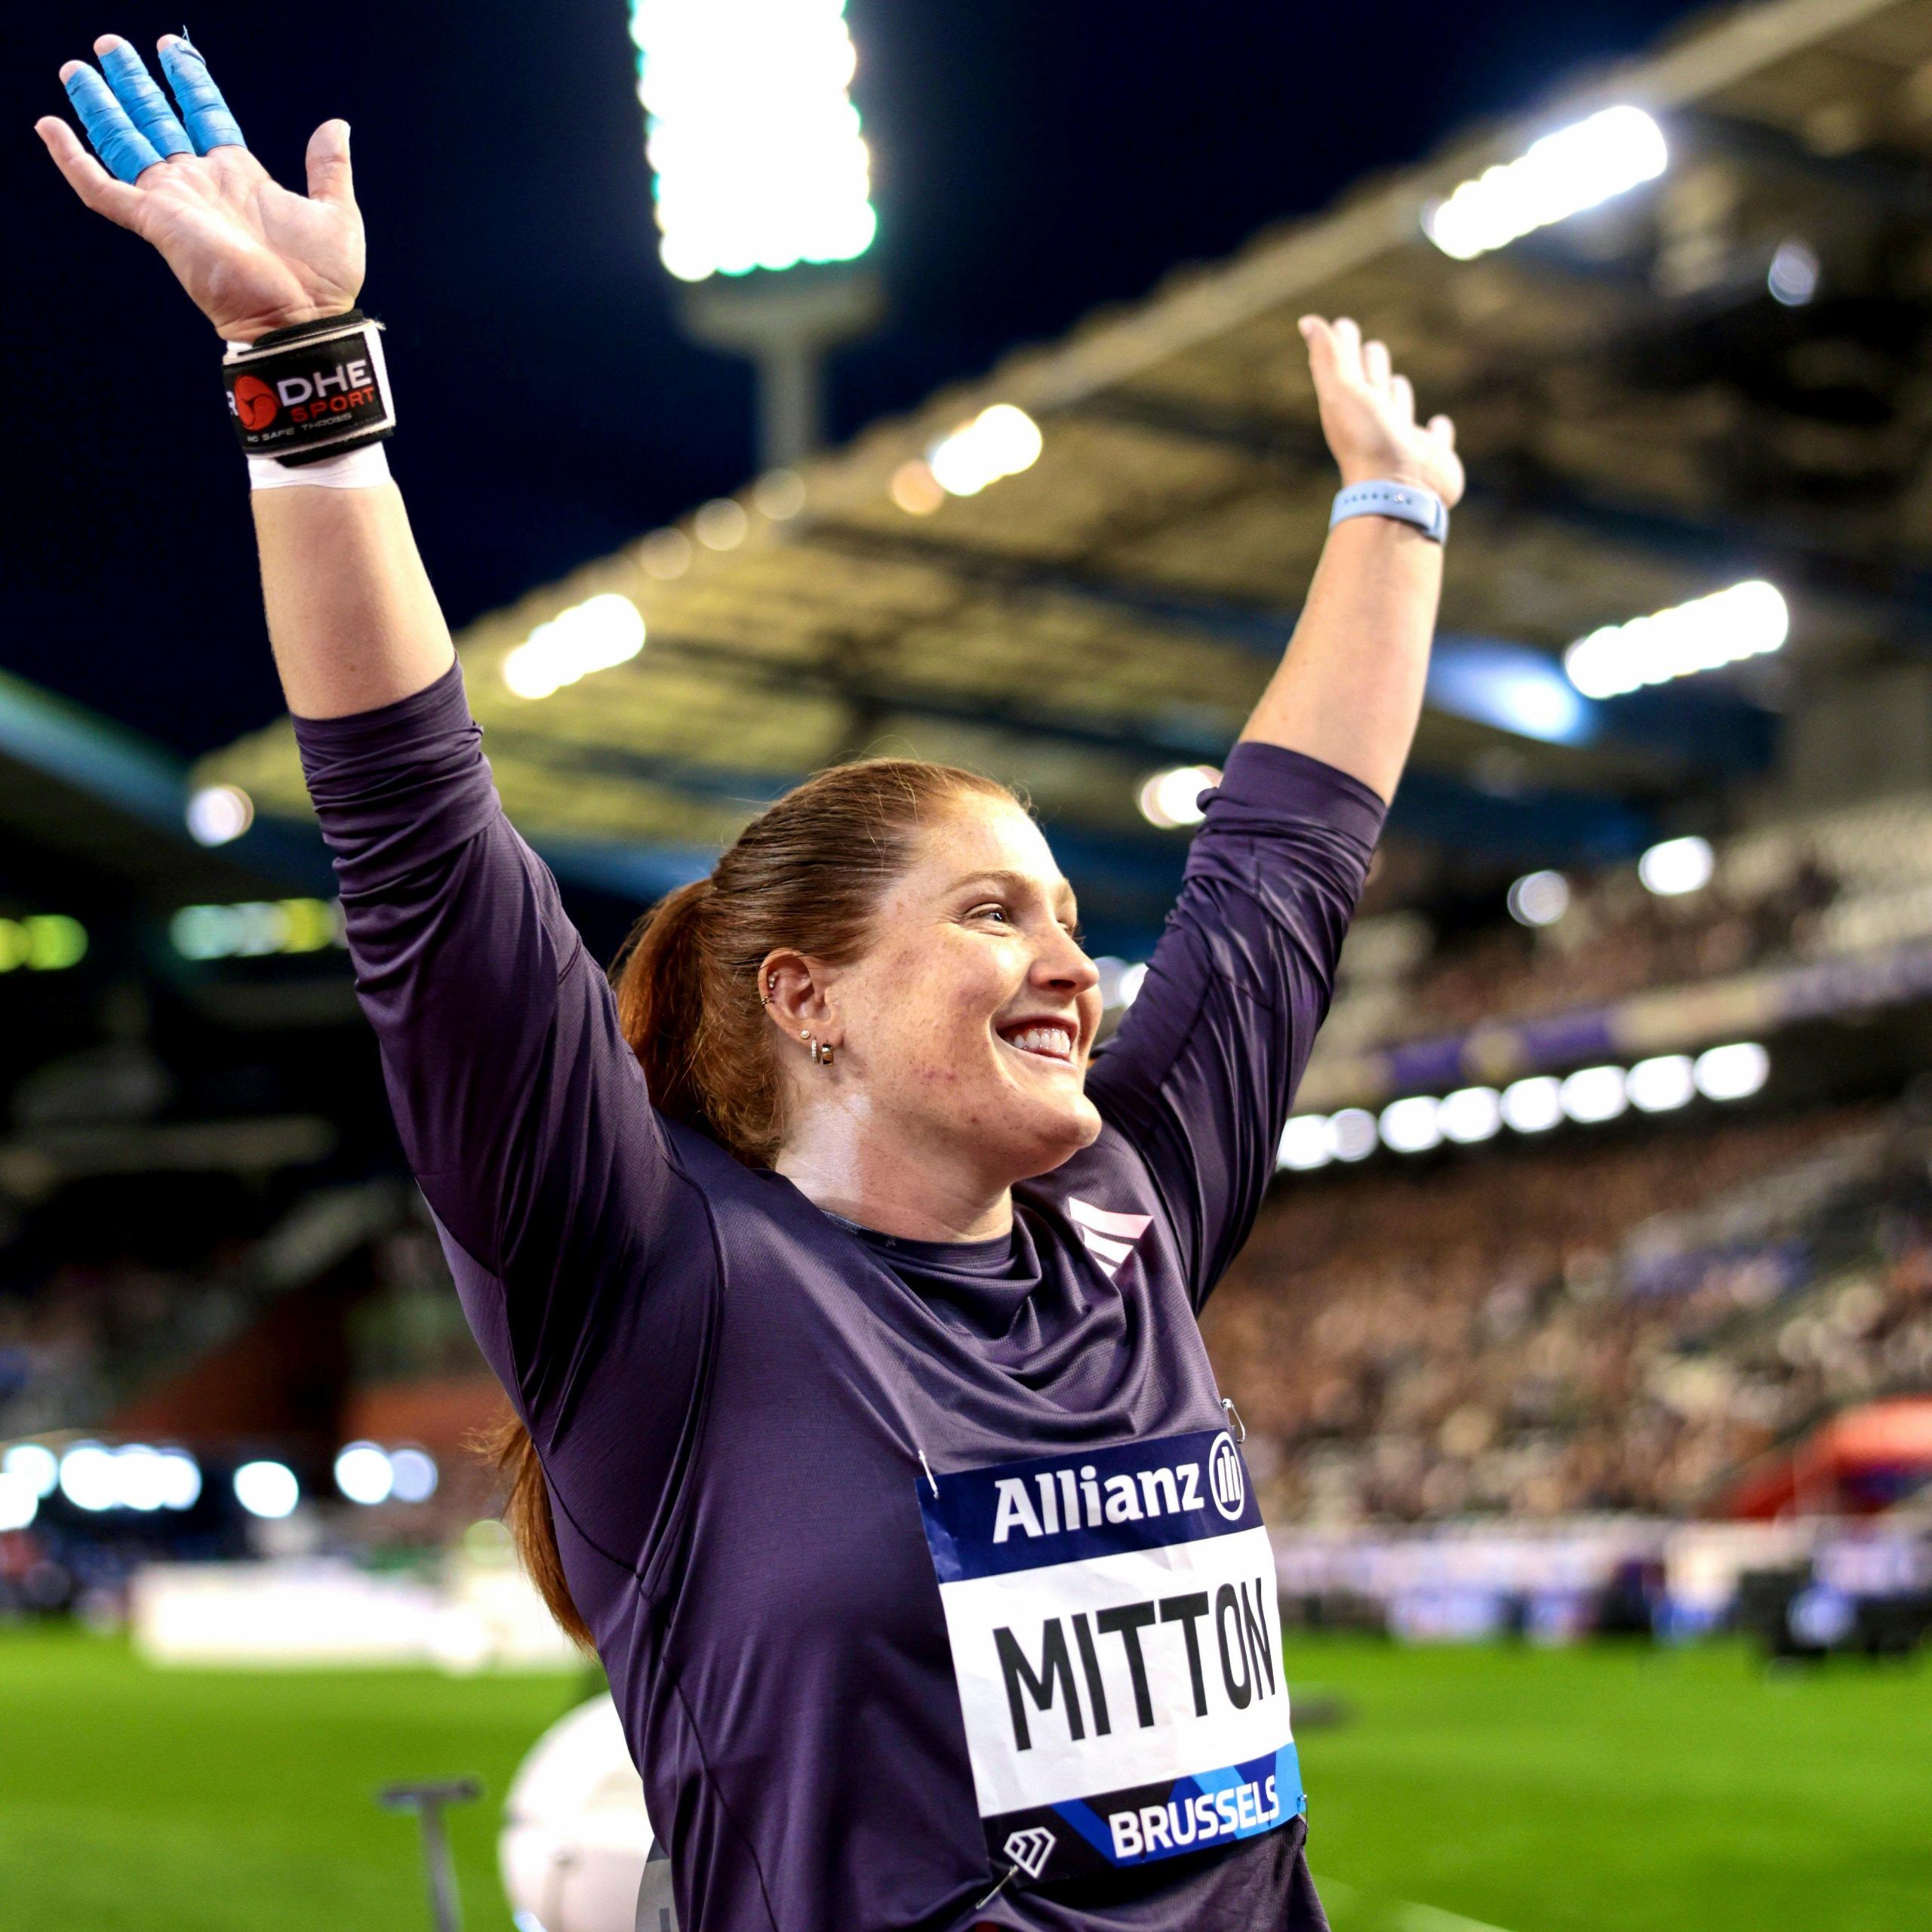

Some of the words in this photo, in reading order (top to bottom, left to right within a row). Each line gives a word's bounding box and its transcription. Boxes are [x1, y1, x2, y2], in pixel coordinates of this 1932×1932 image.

[262, 427, 295, 441] SAFE
[291, 386, 374, 423] SPORT
[993, 1463, 1204, 1544] Allianz
[992, 1577, 1275, 1751] MITTON
[1109, 1775, 1279, 1859] BRUSSELS
